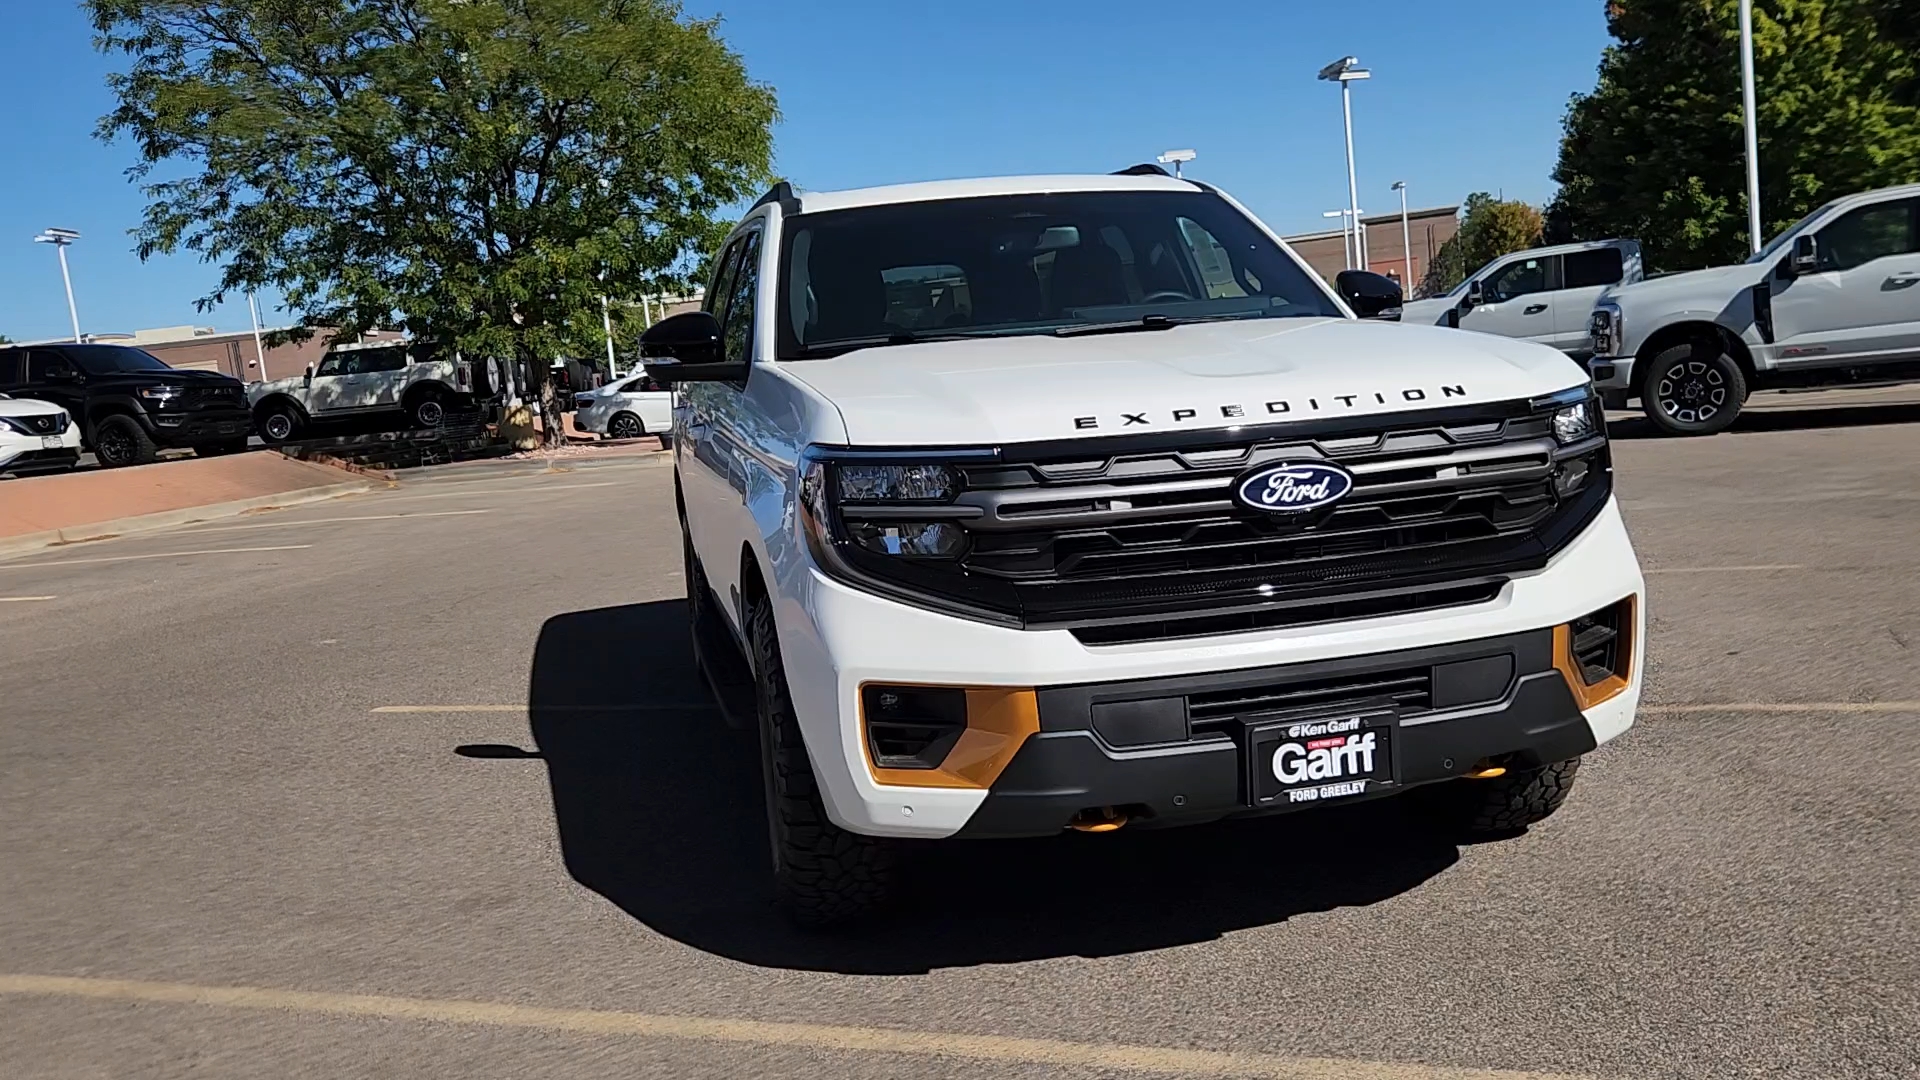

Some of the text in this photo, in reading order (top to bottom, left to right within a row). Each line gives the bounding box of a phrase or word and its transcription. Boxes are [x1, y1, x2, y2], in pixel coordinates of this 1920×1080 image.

[1074, 385, 1466, 429] EXPEDITION
[1261, 471, 1330, 504] Ford
[1327, 718, 1360, 733] Garff
[1272, 732, 1376, 785] Garff
[1289, 781, 1366, 803] FORD GREELEY
